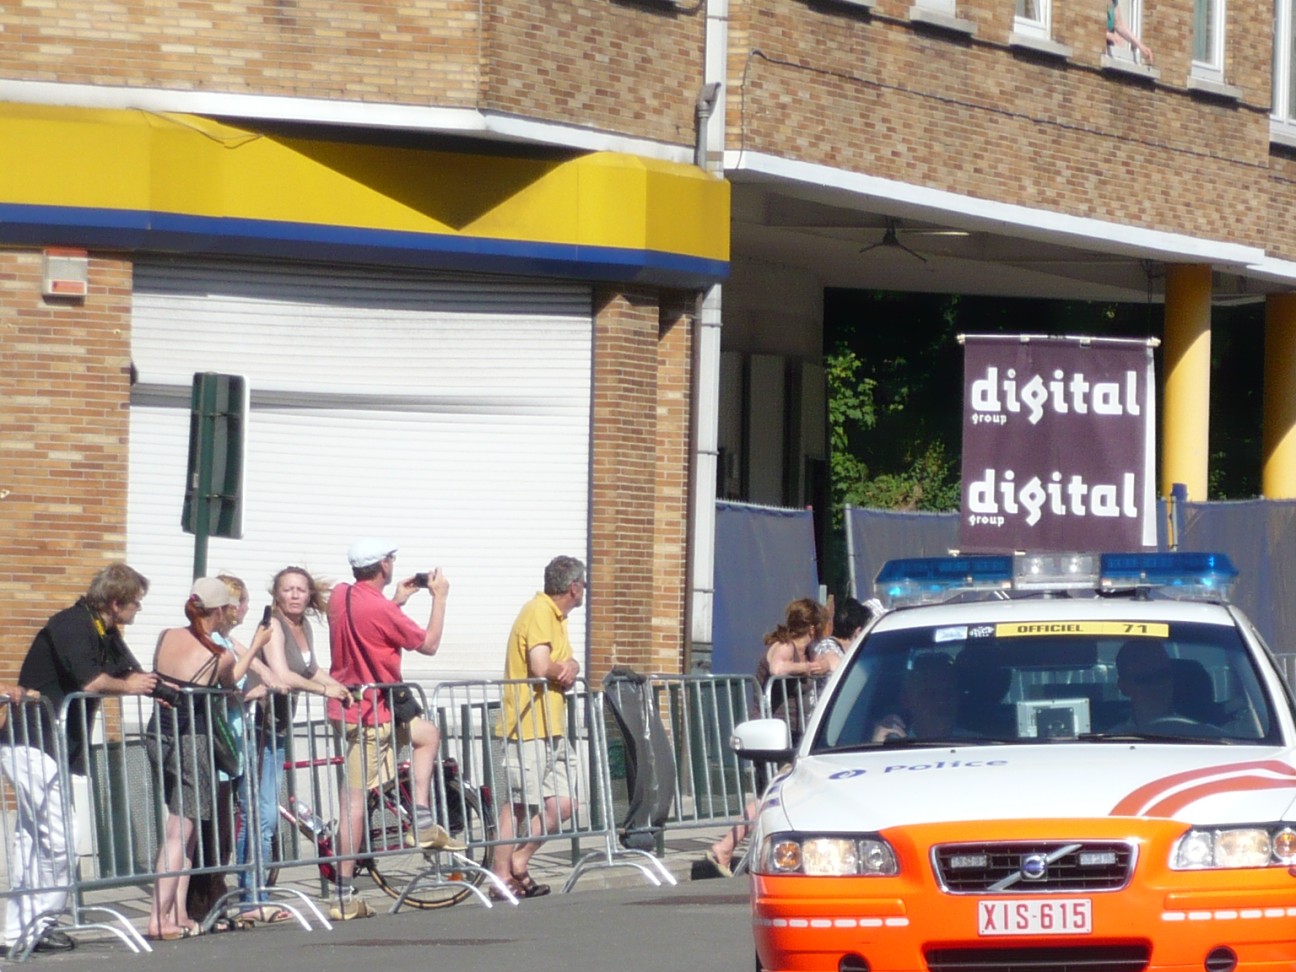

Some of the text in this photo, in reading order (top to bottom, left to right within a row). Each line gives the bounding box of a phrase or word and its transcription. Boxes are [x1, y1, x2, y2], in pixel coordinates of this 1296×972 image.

[971, 367, 1140, 425] digital
[972, 412, 1007, 425] group
[968, 469, 1138, 526] digital
[968, 515, 1004, 526] group
[1017, 624, 1148, 633] OFFICIEL 71
[883, 760, 1008, 773] Police
[984, 903, 1086, 930] XIS-615
